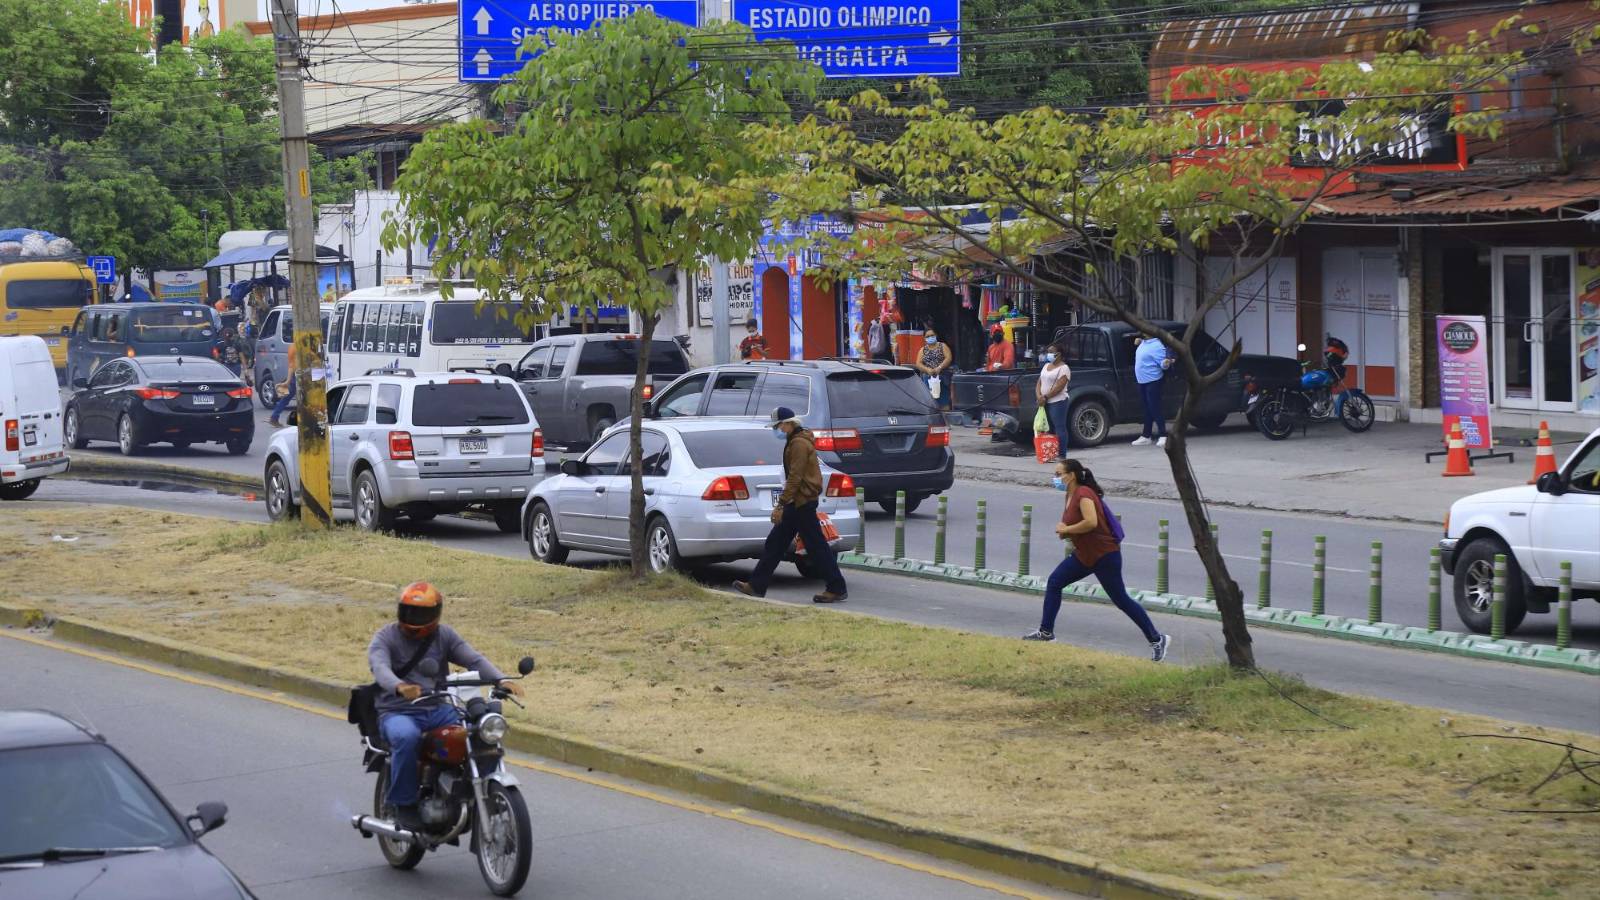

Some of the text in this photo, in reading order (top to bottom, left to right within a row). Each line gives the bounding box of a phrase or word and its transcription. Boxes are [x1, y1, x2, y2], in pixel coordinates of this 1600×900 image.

[750, 6, 931, 29] ESTADIO OLIMPICO
[795, 45, 908, 67] UCIGALPA
